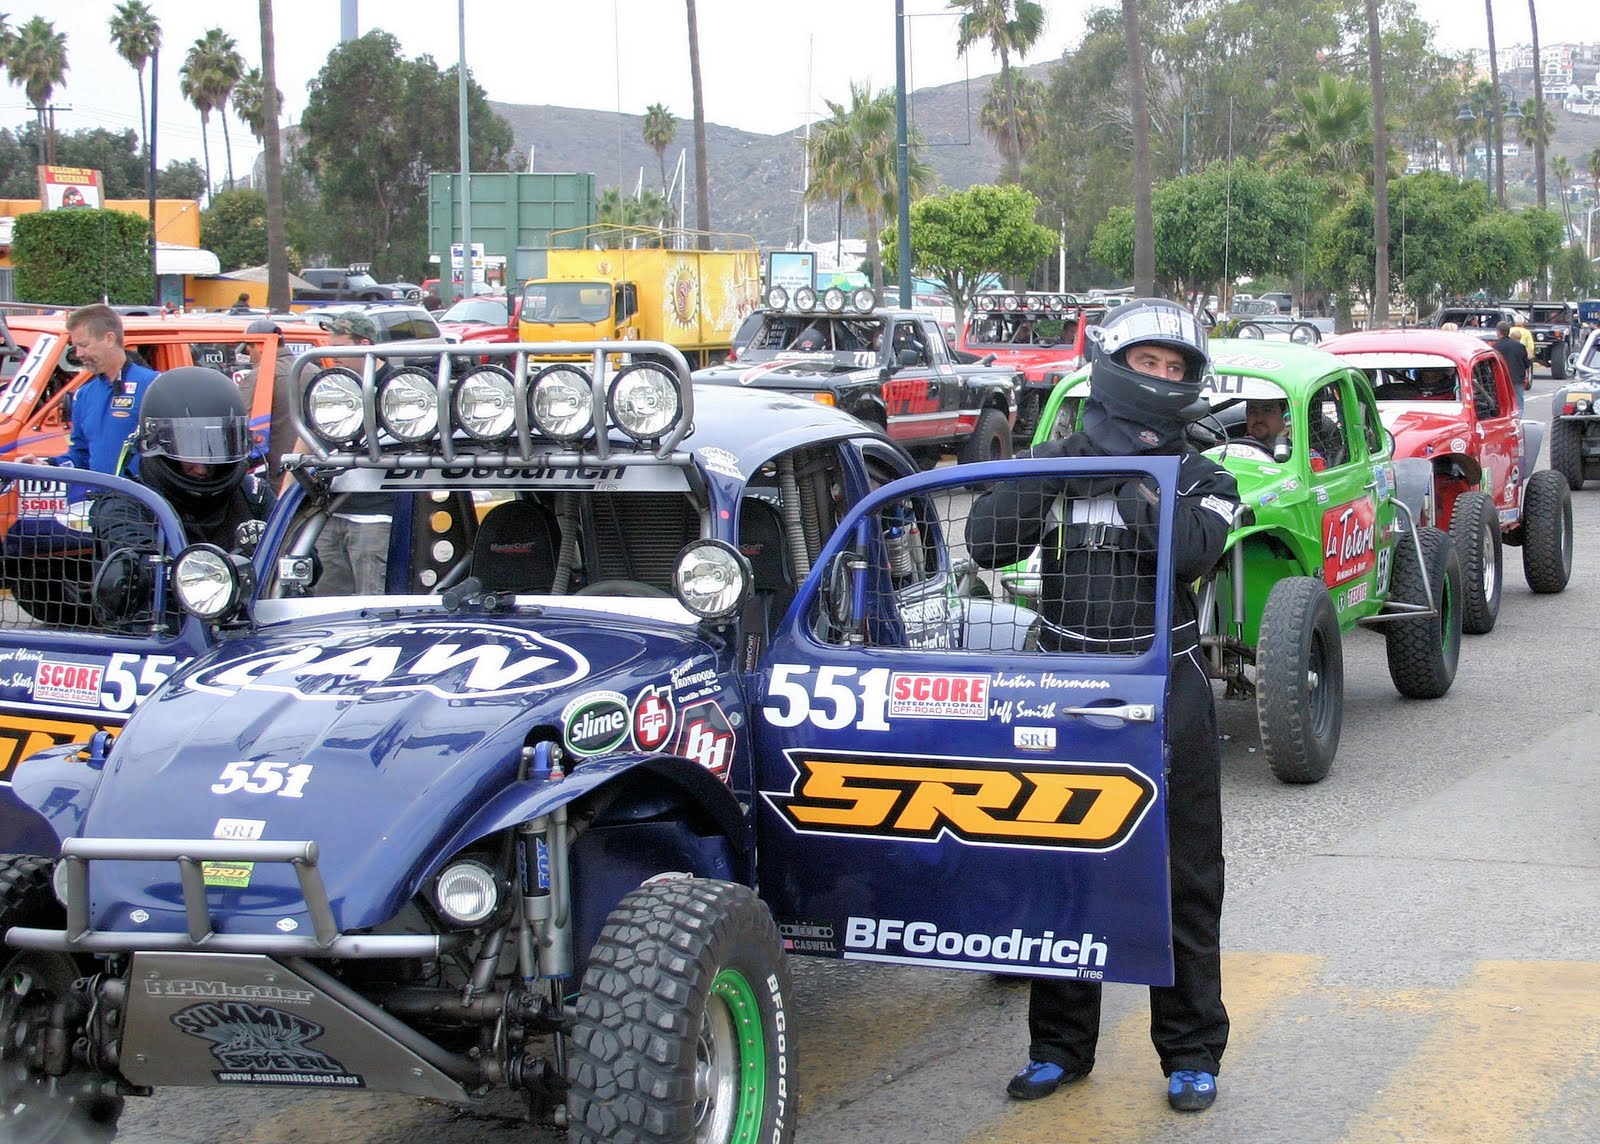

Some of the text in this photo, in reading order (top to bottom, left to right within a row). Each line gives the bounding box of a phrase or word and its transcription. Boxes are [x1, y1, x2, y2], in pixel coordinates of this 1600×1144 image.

[22, 500, 66, 511] SCORE
[39, 664, 101, 691] SCORE
[101, 652, 195, 712] 55
[992, 671, 1111, 690] Justin Herrmann
[37, 686, 97, 696] INTERNATIONAL
[71, 693, 97, 702] RACING
[763, 663, 891, 731] 551
[894, 676, 985, 703] SCORE
[893, 701, 983, 709] INTERNATIONAL
[893, 706, 984, 716] OFF-ROAD RACING
[989, 699, 1057, 724] Jeff Smith
[571, 710, 626, 743] slime
[210, 761, 314, 798] 551
[786, 760, 1145, 841] SRD
[793, 939, 837, 952] CASWELL
[844, 916, 1108, 967] BFGoodrich
[1077, 966, 1104, 980] Tires
[144, 979, 315, 1001] RPMuffler
[176, 1001, 319, 1037] SUMMIT
[223, 1053, 343, 1073] STEEL
[218, 1072, 360, 1086] www.summitsteel.net
